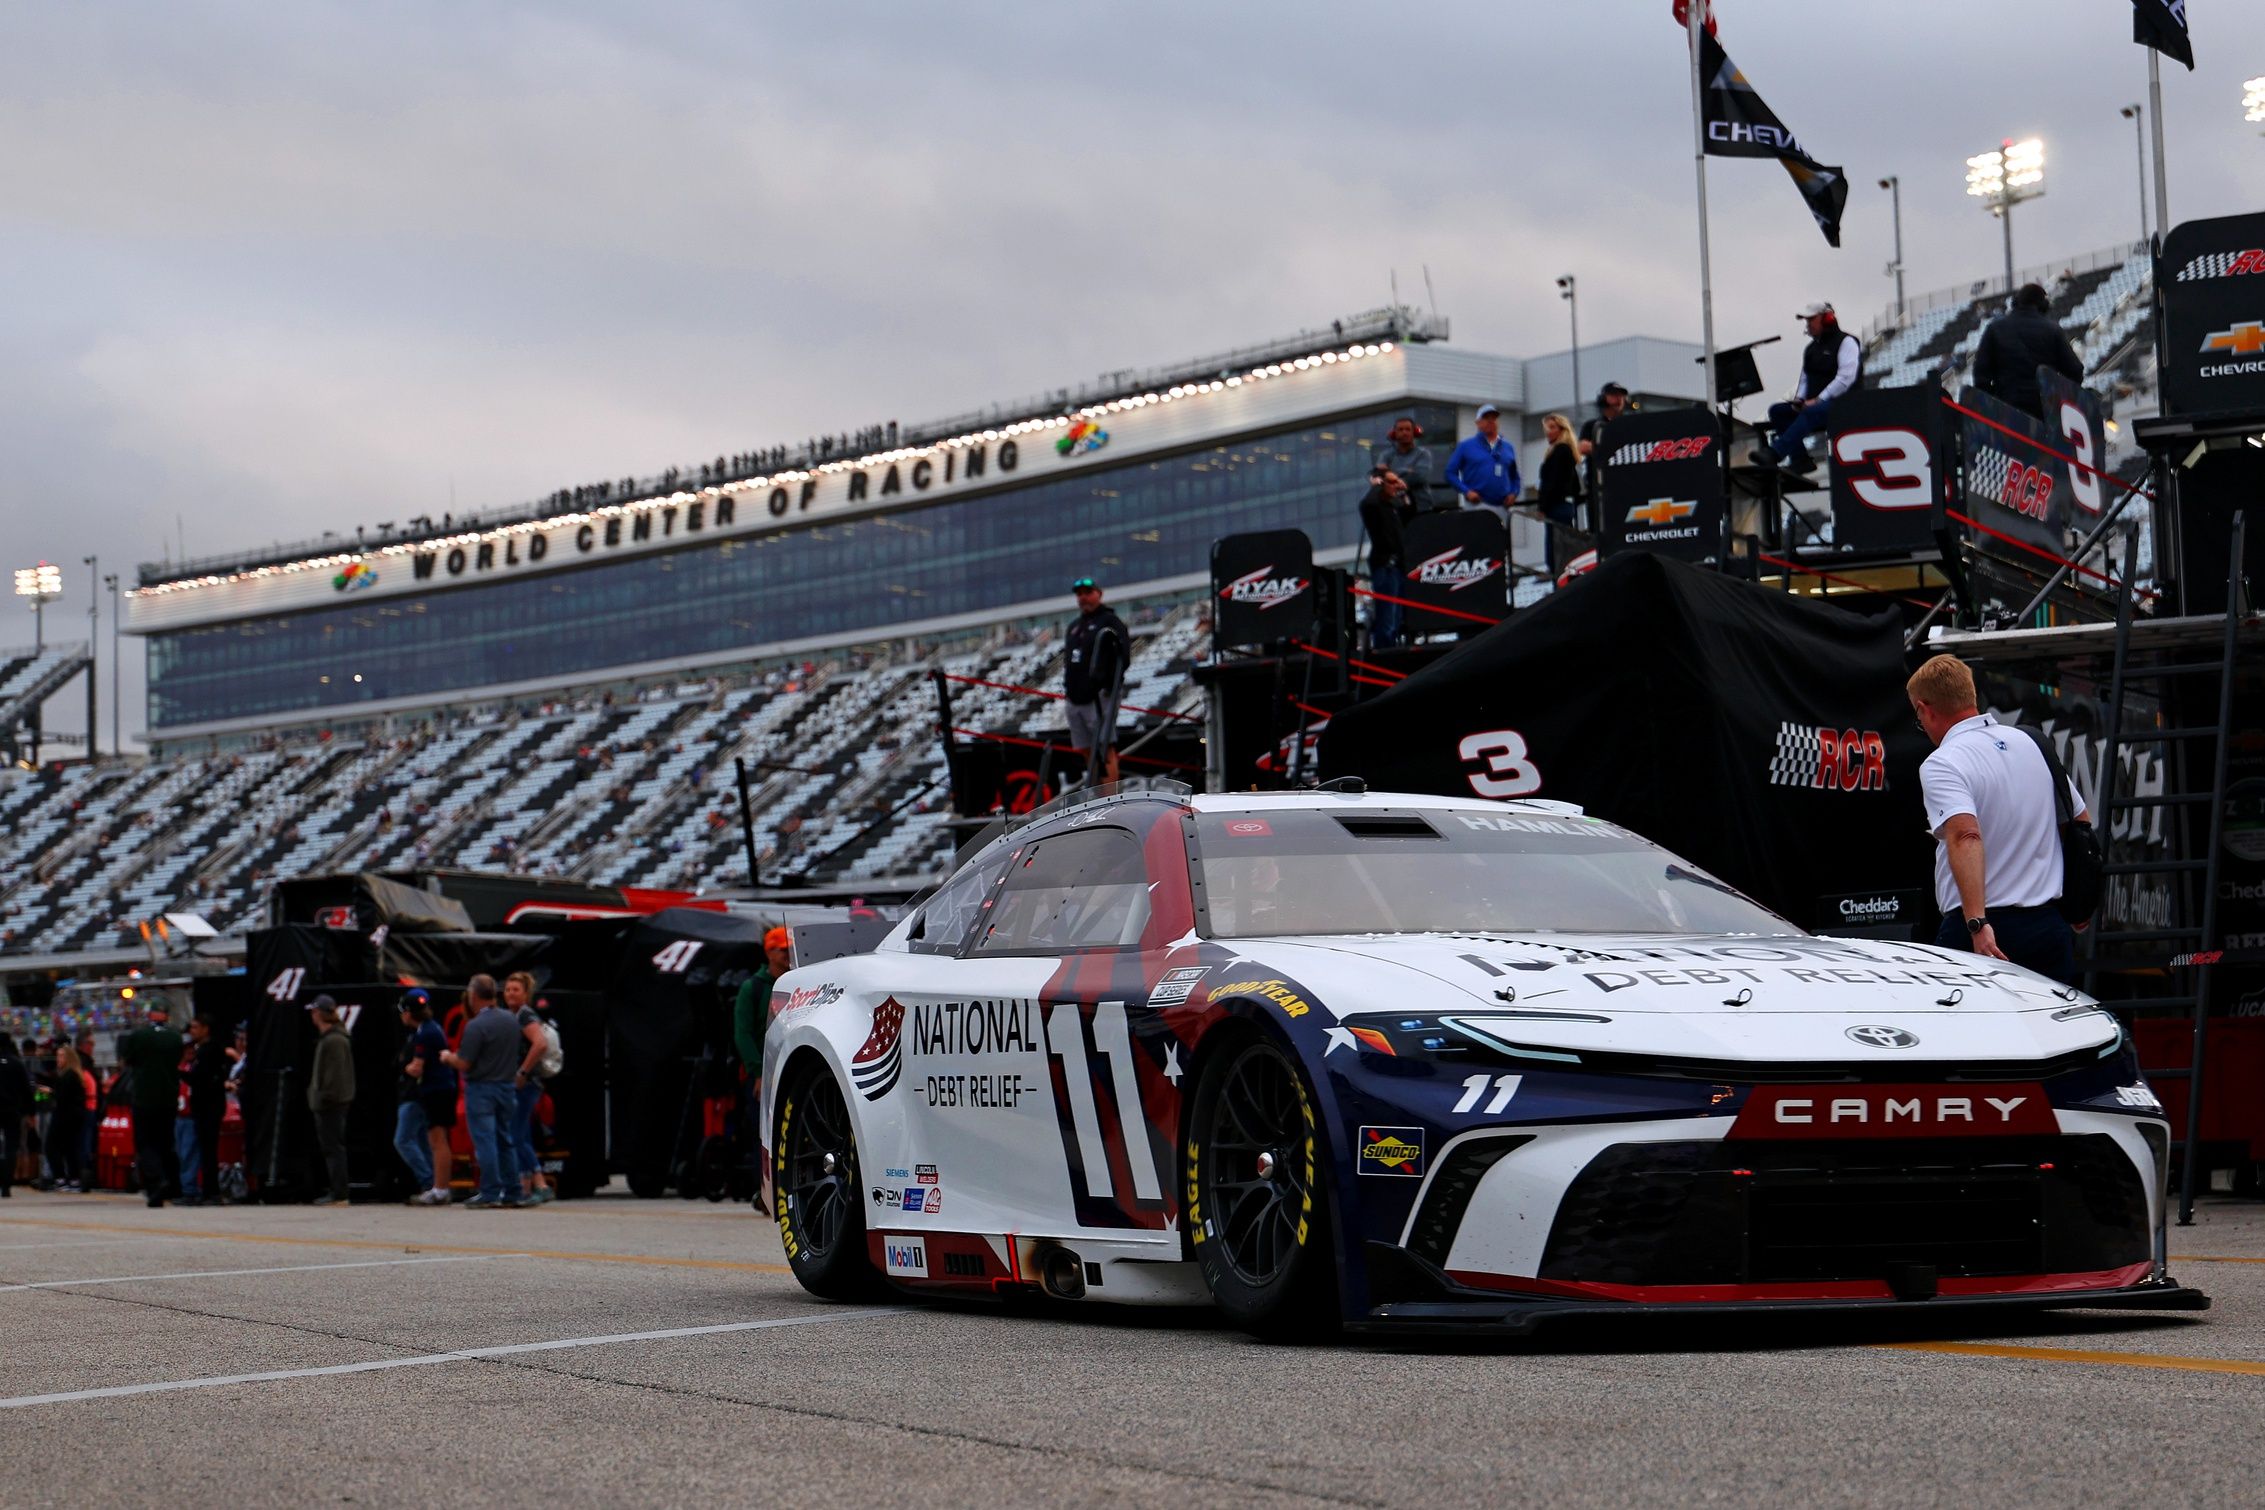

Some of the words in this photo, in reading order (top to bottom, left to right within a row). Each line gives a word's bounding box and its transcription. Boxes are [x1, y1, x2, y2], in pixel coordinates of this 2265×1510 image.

[1646, 435, 1711, 462] RCR
[1833, 426, 1931, 511] 3
[2000, 457, 2054, 522] RCR
[414, 533, 548, 579] WORLD
[576, 496, 736, 553] CENTER
[768, 482, 817, 517] OF
[848, 440, 1019, 501] RACING
[1625, 527, 1700, 543] CHEVROLET
[1420, 557, 1492, 579] HYAK
[1231, 577, 1301, 596] HYAK
[1457, 729, 1542, 799] 3
[1813, 727, 1885, 792] RCR
[1456, 816, 1623, 839] HAMLIN
[1840, 896, 1899, 914] Cheddar's
[651, 940, 705, 974] 41
[265, 966, 307, 1002] 41
[1582, 968, 1765, 993] DEBT
[1780, 968, 1993, 989] RELIEF
[1207, 979, 1311, 1018] GOODYEAR
[914, 998, 1037, 1056] NATIONAL
[928, 1075, 965, 1108] DEBT
[970, 1075, 1022, 1108] RELIEF
[1047, 1000, 1163, 1200] 11
[1452, 1074, 1523, 1114] 11
[1775, 1097, 2028, 1123] CAMRY
[1365, 1145, 1418, 1159] SUNOCO
[886, 1168, 909, 1178] SIEMENS
[916, 1165, 936, 1174] LINCOLN
[886, 1189, 901, 1201] DN
[1187, 1138, 1206, 1246] EAGLE
[888, 1246, 914, 1267] Mobil
